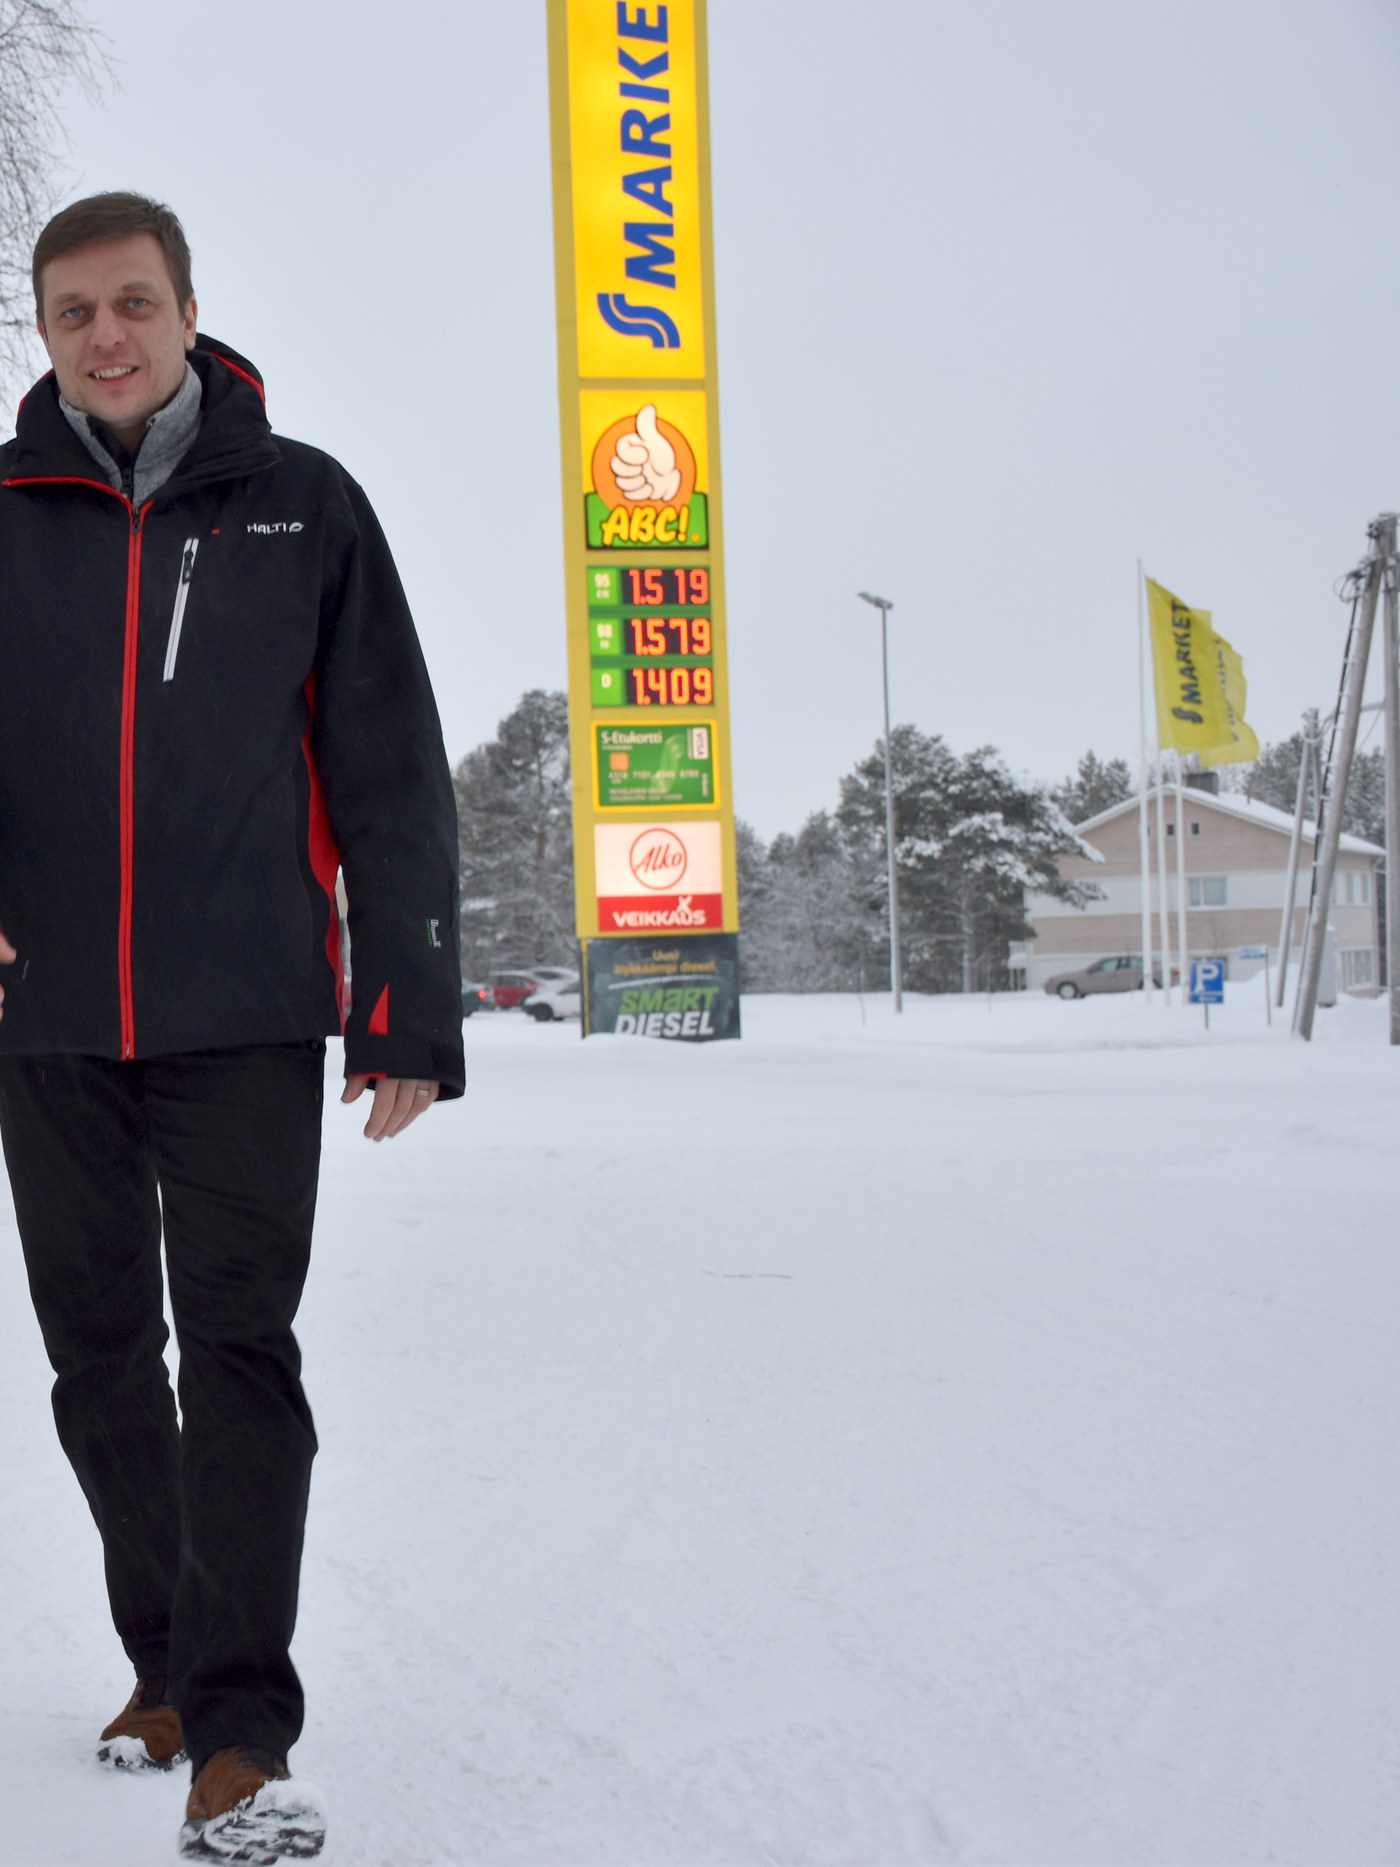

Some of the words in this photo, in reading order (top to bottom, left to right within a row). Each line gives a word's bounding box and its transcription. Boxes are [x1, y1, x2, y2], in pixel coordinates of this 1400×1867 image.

[247, 522, 287, 535] HALTI
[601, 504, 690, 546] ABC!
[1171, 598, 1203, 705] MARKET
[601, 730, 663, 745] S-Etukortti
[633, 843, 683, 874] Alko
[612, 898, 707, 927] VEIKKAUS
[1195, 964, 1219, 992] P
[614, 1010, 715, 1038] DIESEL
